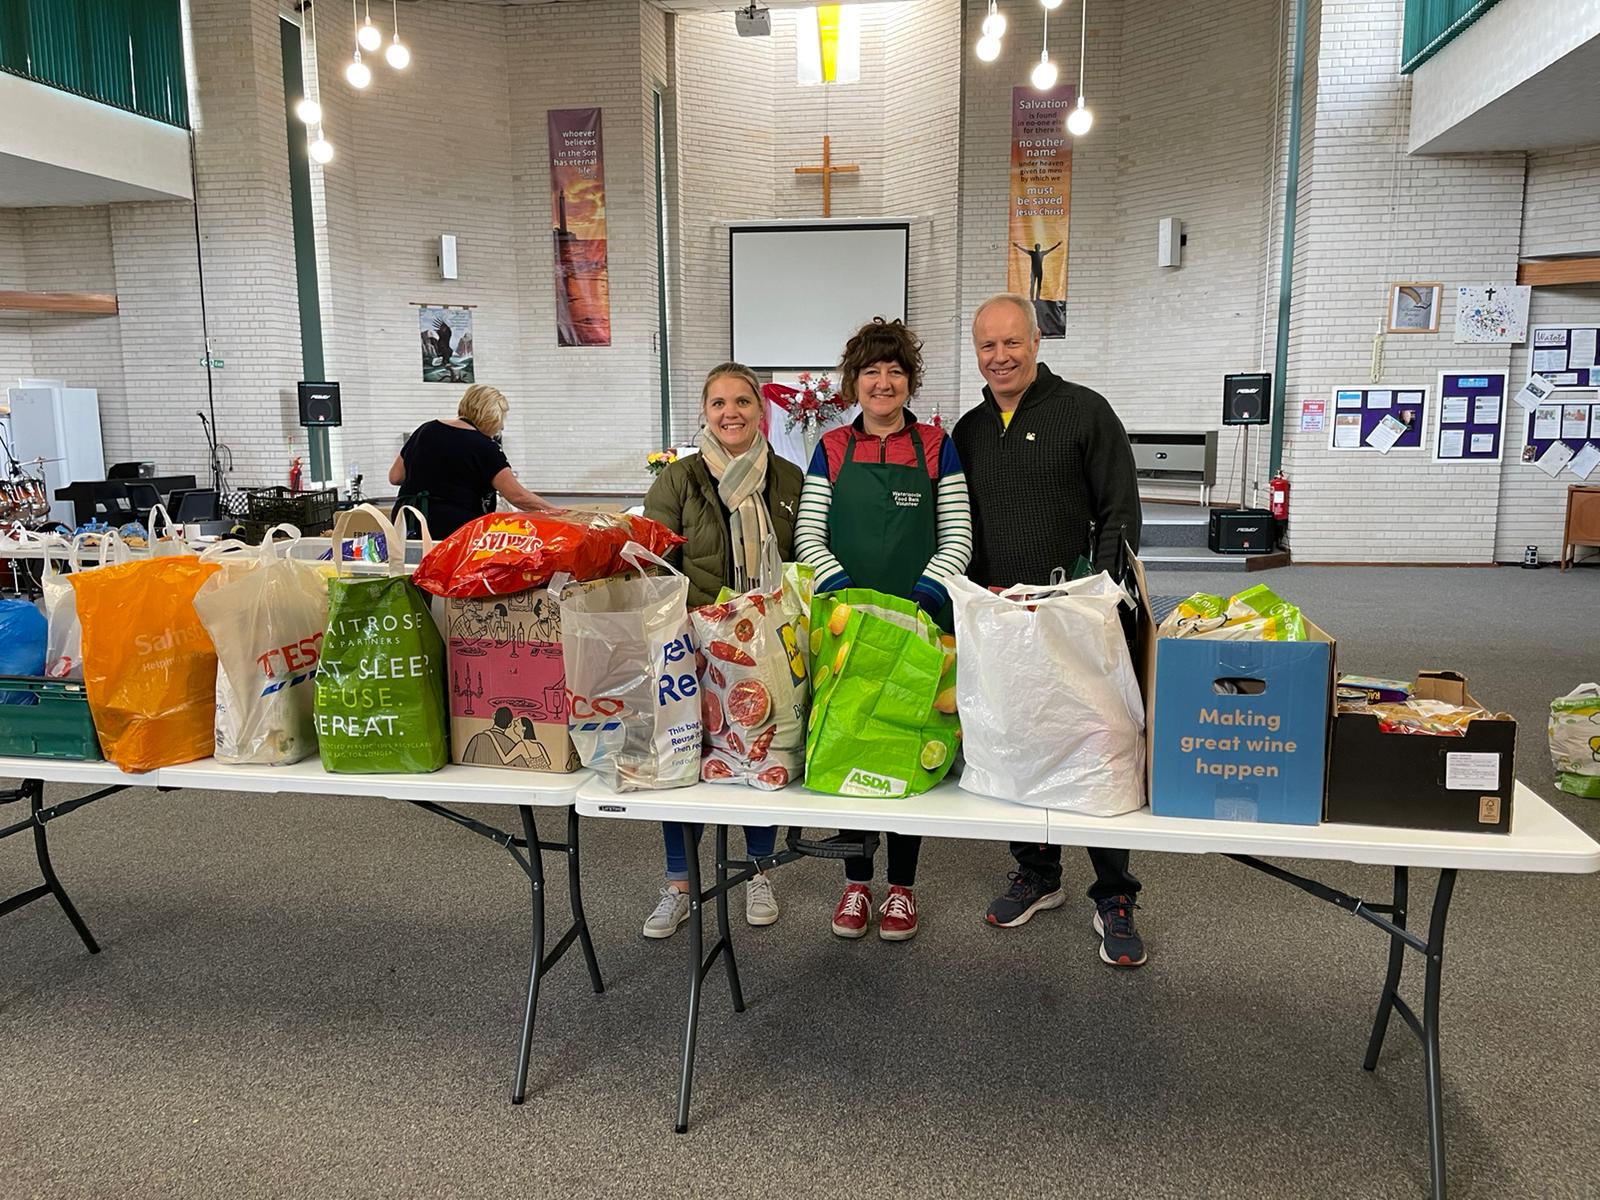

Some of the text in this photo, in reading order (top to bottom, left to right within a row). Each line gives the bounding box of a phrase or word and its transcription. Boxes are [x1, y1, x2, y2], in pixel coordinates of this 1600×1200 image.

[1020, 99, 1068, 109] Salvation
[562, 130, 596, 138] whoever
[565, 139, 596, 147] believes
[1035, 138, 1065, 147] other
[1026, 149, 1057, 157] name
[569, 158, 598, 166] eternal
[1027, 186, 1054, 194] must
[1017, 196, 1063, 205] be saved
[1040, 208, 1064, 216] Christ
[327, 613, 422, 636] AITROSE
[134, 620, 205, 656] Sainsb
[340, 637, 401, 648] PARTNERS
[315, 686, 403, 708] E-USE.
[1199, 708, 1281, 731] Making
[668, 726, 685, 736] This
[671, 734, 695, 746] Reuse
[1180, 736, 1297, 753] great wine
[1195, 758, 1279, 779] happen
[848, 772, 891, 794] ASDA
